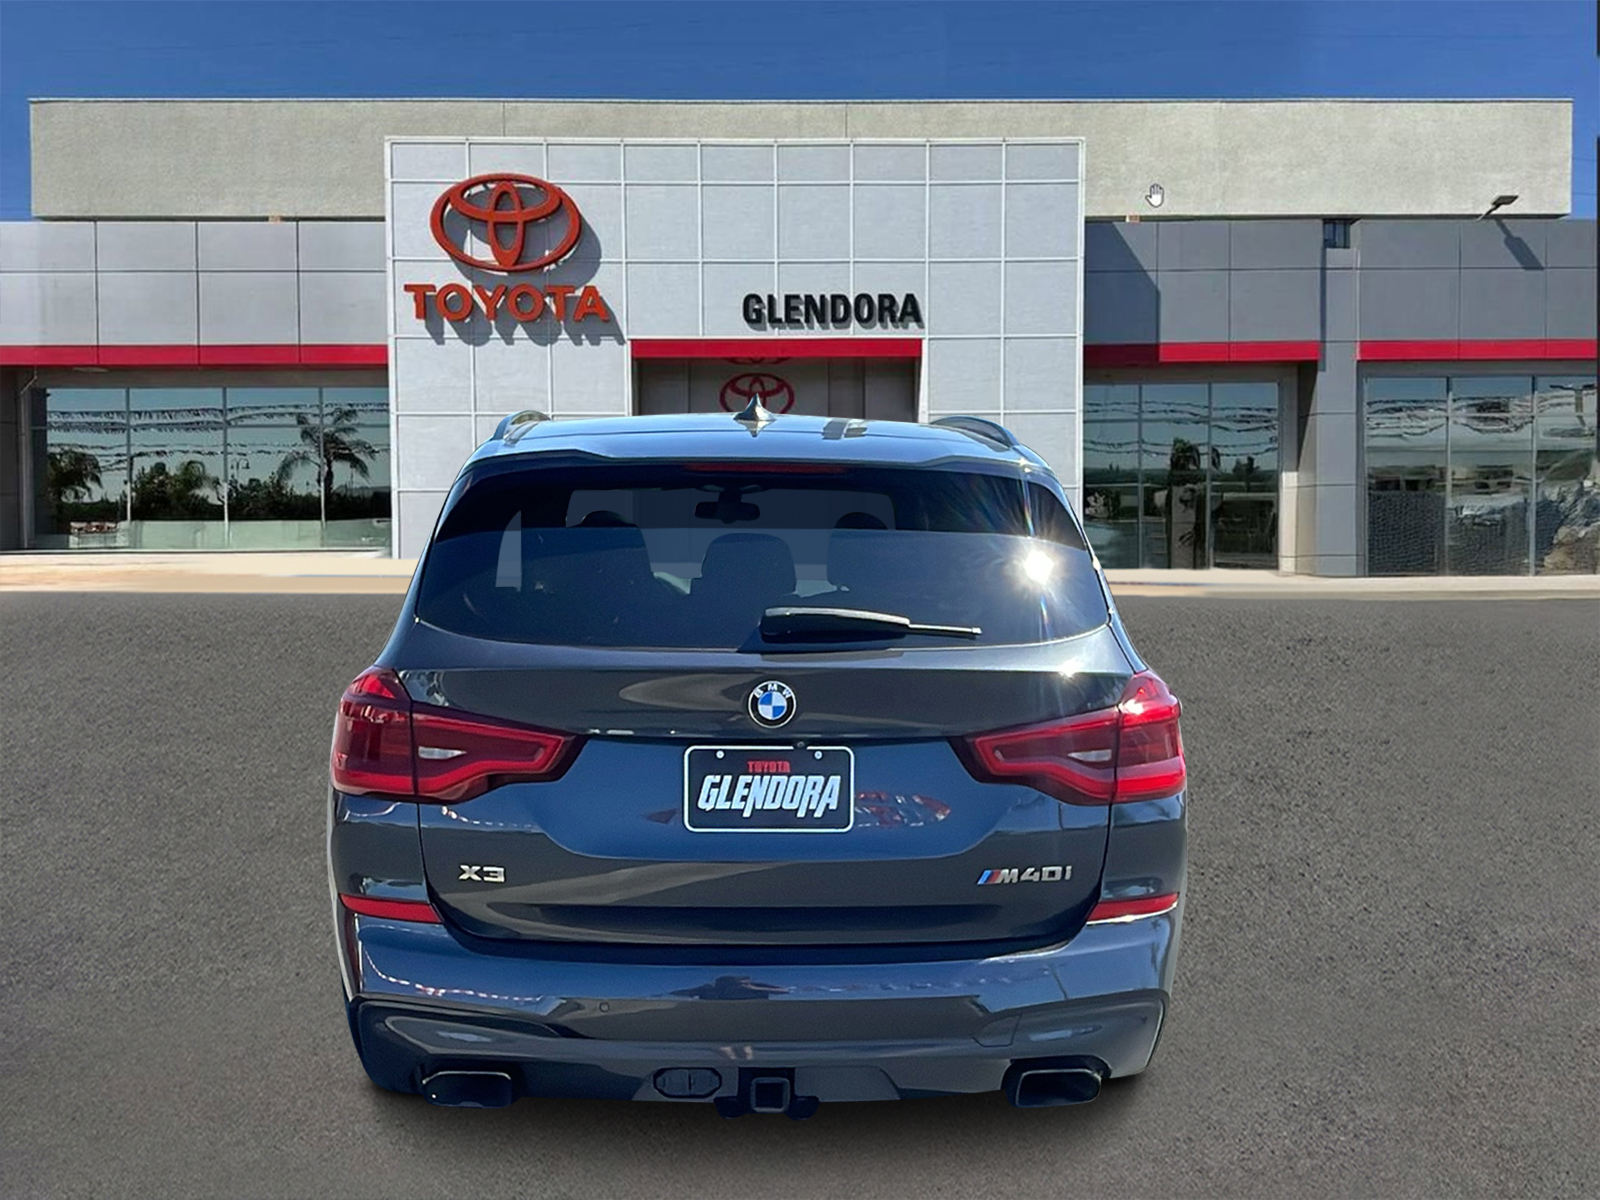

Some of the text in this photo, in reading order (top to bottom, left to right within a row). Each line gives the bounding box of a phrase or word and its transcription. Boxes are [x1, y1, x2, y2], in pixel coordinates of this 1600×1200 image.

[403, 283, 610, 323] TOYOTA
[742, 293, 922, 325] GLENDORA
[753, 683, 793, 699] BMW
[747, 761, 791, 773] TOYOTA
[697, 775, 841, 818] GLENDORA
[458, 864, 505, 882] X3
